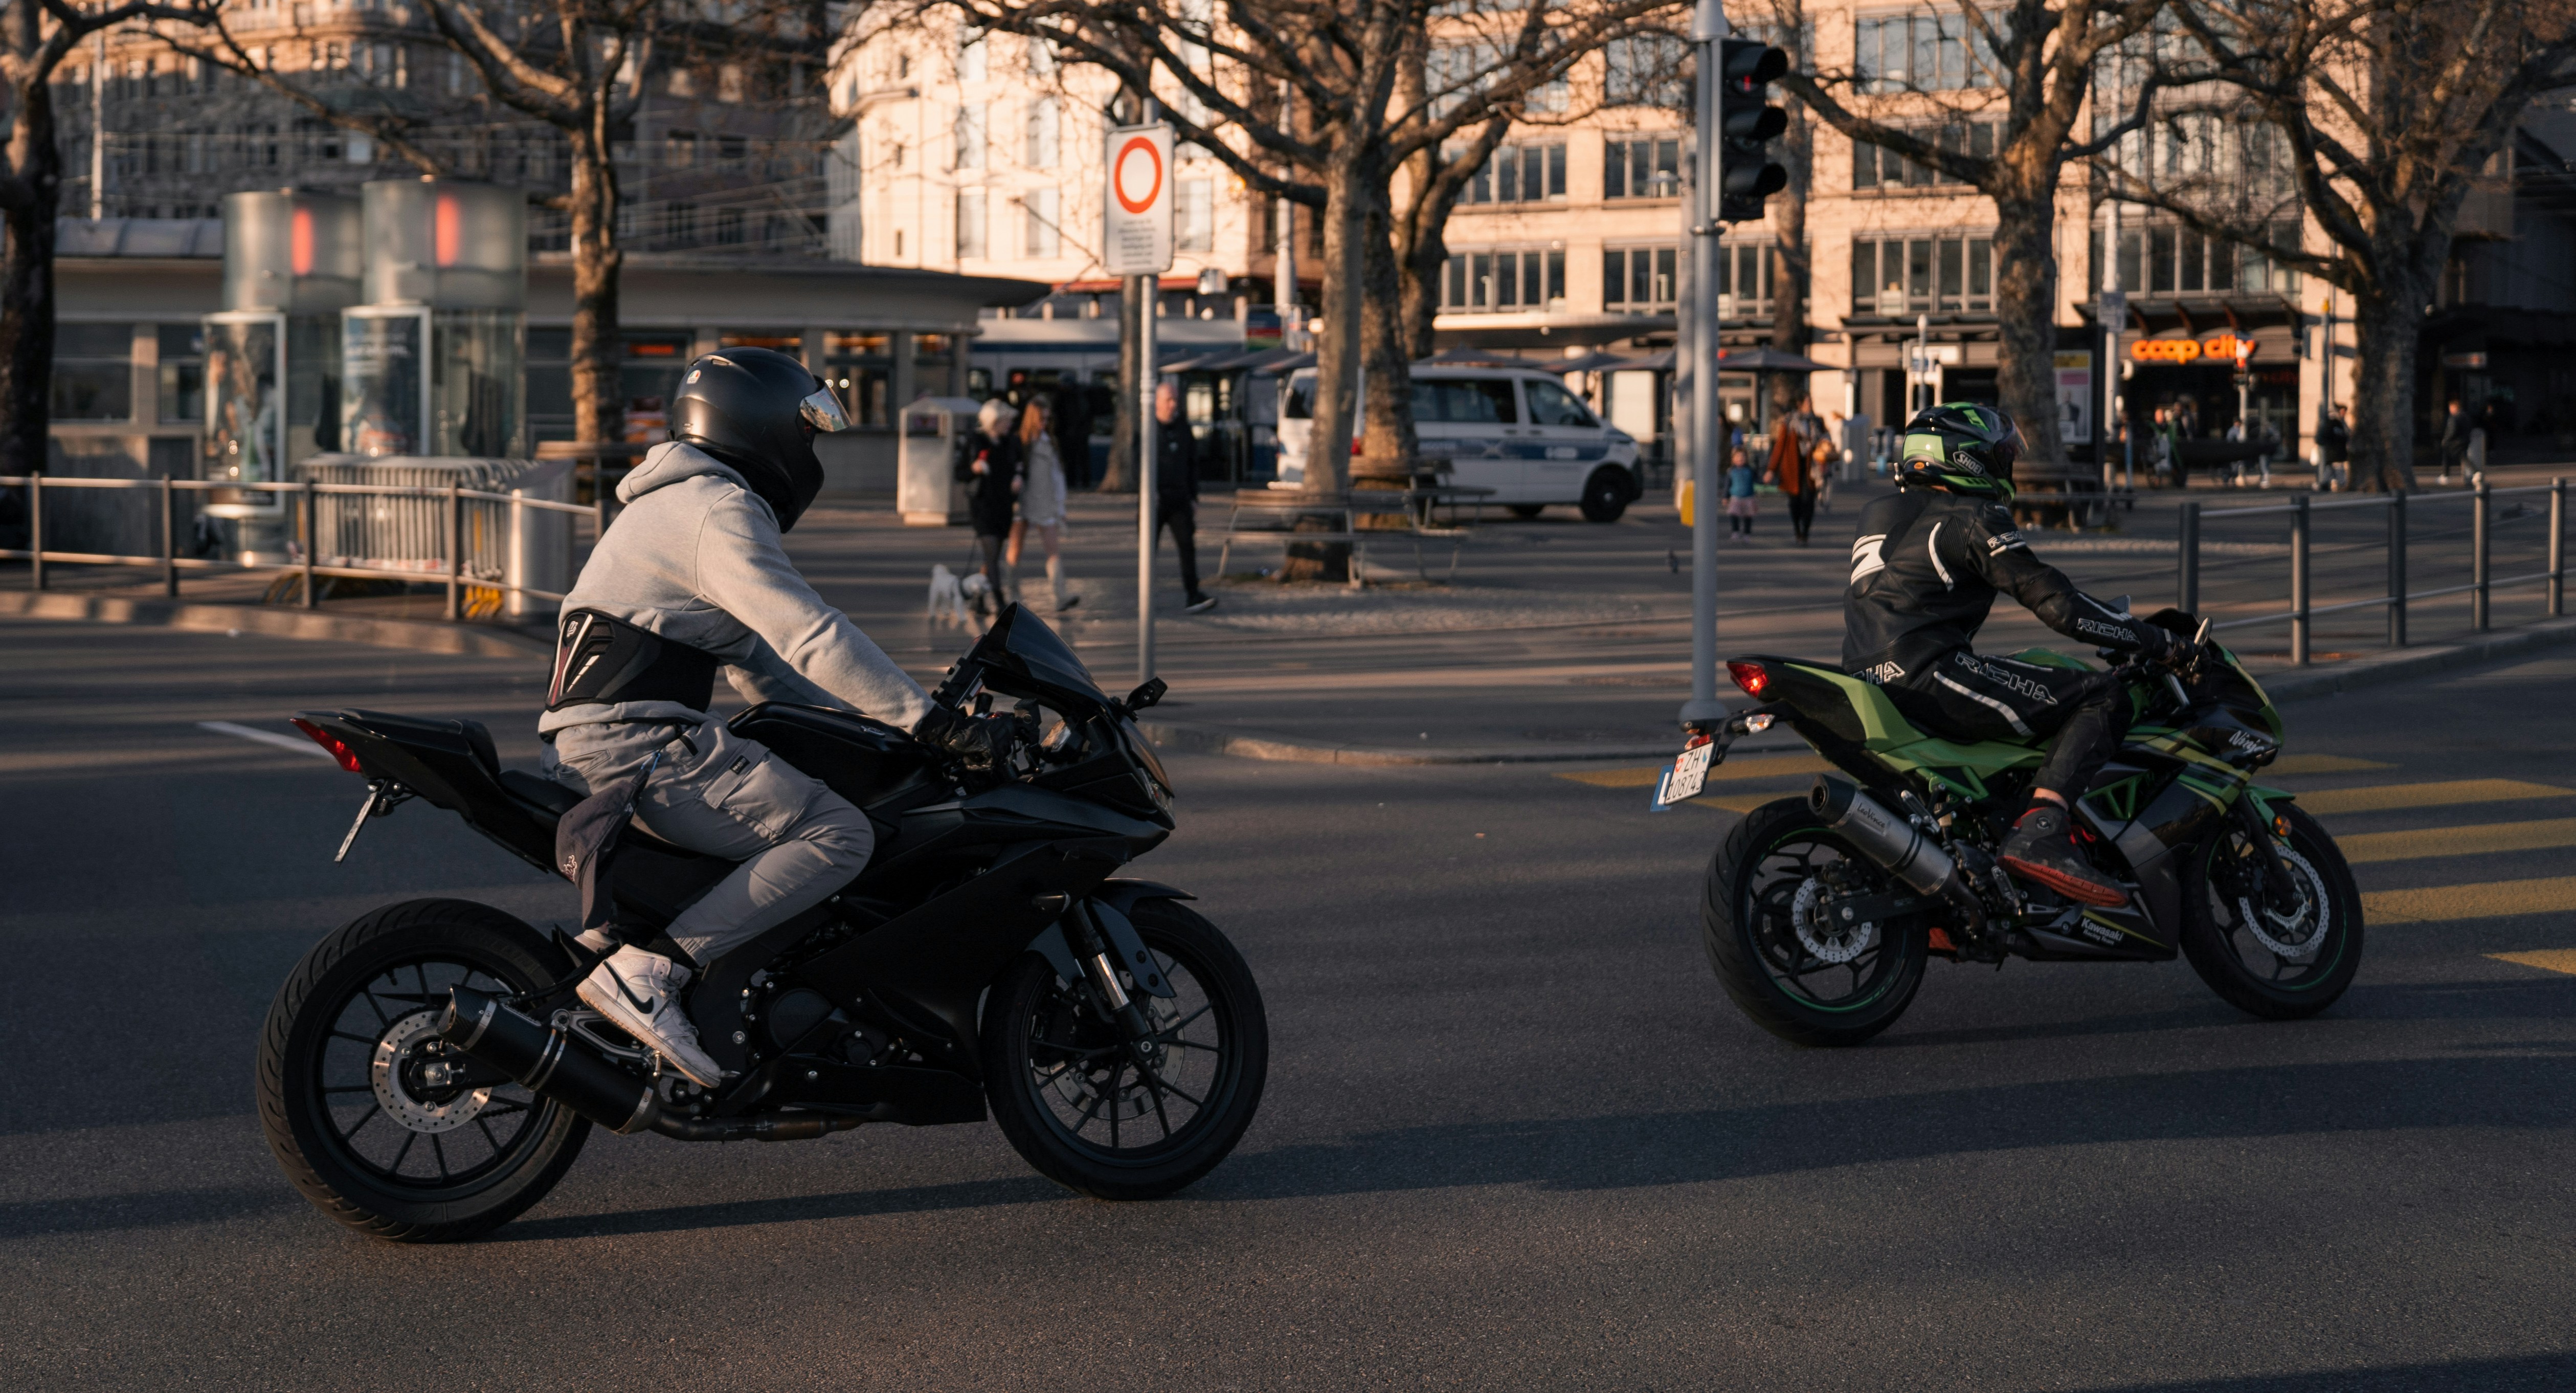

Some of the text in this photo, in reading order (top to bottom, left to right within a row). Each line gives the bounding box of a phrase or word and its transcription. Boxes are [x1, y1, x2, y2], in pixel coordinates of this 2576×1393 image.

[2131, 340, 2200, 365] coop
[1957, 453, 1983, 475] SHOEI
[2076, 617, 2140, 645] RICHA
[1955, 651, 2058, 705] RICHA
[2228, 730, 2265, 754] Ninja
[1684, 747, 1702, 772] ZH
[1666, 770, 1706, 801] 108743
[1857, 802, 1886, 828] LeoVince
[2081, 917, 2124, 941] Kawasaki
